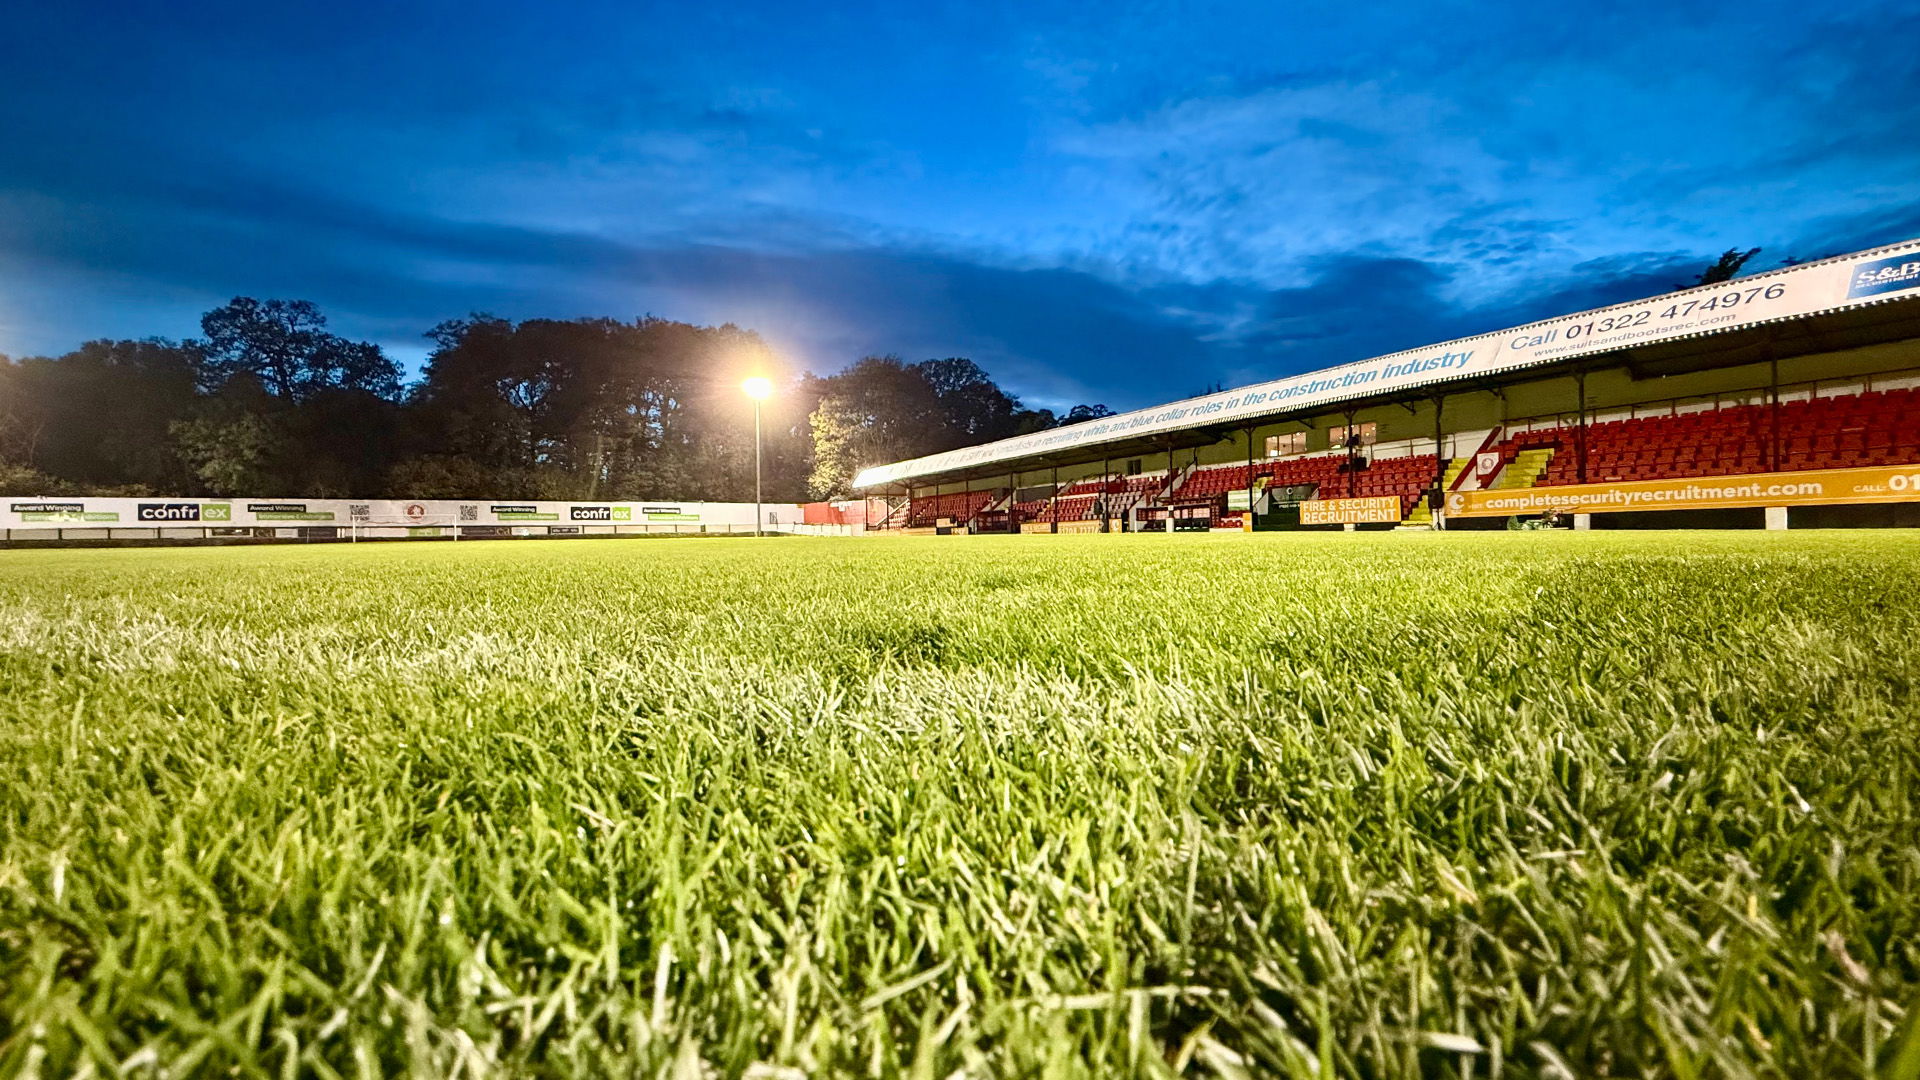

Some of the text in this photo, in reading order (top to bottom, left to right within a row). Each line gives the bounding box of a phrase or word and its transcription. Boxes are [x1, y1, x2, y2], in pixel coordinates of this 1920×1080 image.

[1510, 283, 1786, 350] Call 01322 474976
[1083, 424, 1110, 437] white
[1110, 419, 1131, 432] and
[1130, 415, 1154, 427] blue
[1155, 408, 1191, 423] collar
[1190, 400, 1224, 416] roles
[1225, 396, 1240, 409] in
[1242, 391, 1264, 406] the
[1268, 369, 1377, 402] construction
[1381, 350, 1475, 381] industry
[1888, 474, 1920, 491] 01
[1486, 483, 1822, 509] completesecurityrecruitment.com
[45, 504, 81, 512] Winning
[1303, 501, 1326, 512] FIRE
[1328, 500, 1336, 511] &
[1338, 498, 1395, 511] SECURITY
[204, 508, 227, 519] ex
[1303, 509, 1396, 523] RECRUITMENT
